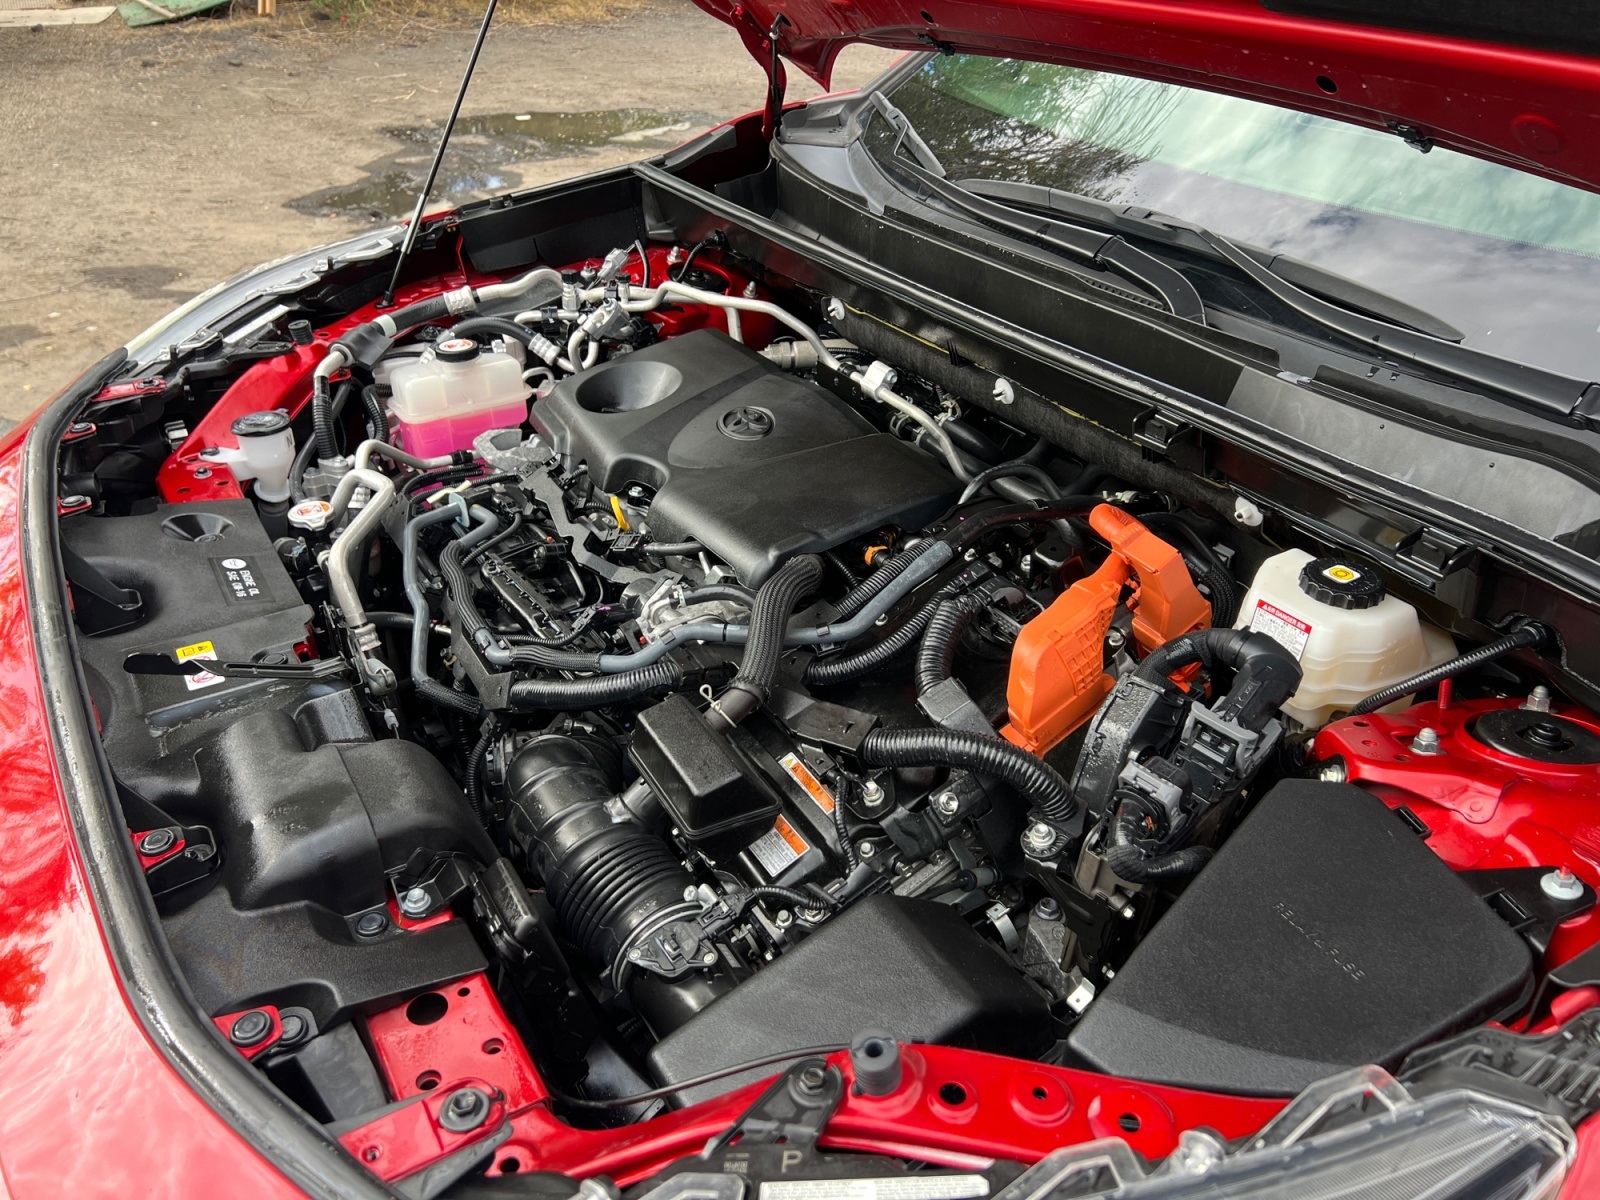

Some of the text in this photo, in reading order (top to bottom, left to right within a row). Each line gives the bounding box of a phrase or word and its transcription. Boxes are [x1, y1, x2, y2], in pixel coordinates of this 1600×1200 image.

[226, 570, 240, 581] SAE
[239, 569, 260, 597] ENGINE OIL
[1274, 608, 1298, 627] DANGER
[781, 1149, 803, 1173] P
